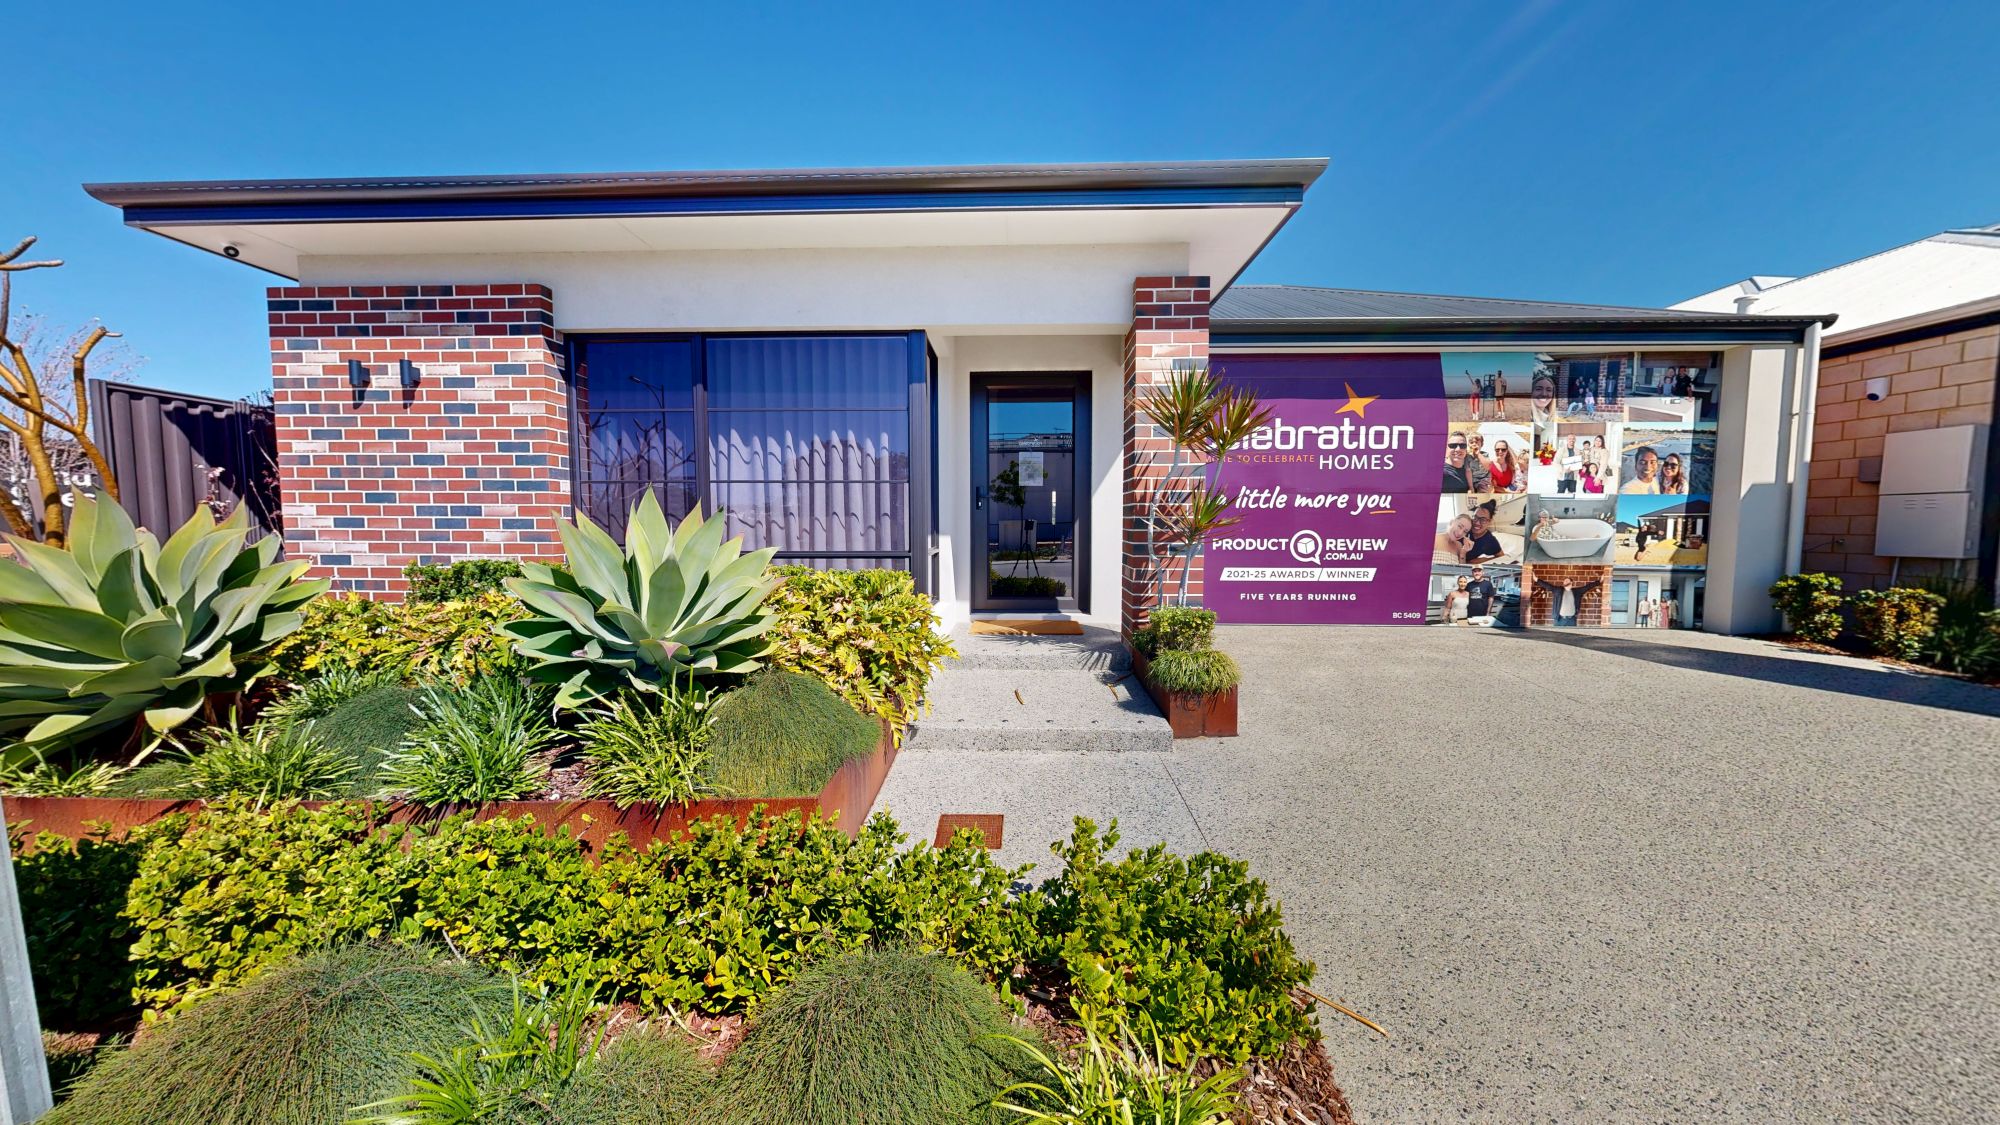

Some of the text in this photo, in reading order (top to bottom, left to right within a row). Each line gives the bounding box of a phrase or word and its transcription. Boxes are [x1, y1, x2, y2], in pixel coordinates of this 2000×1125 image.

[1238, 454, 1251, 463] TO
[1253, 454, 1316, 463] CELEBRATE
[1319, 454, 1395, 470] HOMES
[1235, 485, 1288, 509] little
[1294, 493, 1349, 509] more
[1350, 493, 1392, 516] you
[1212, 538, 1388, 551] PRODUCT REVIEW
[1323, 552, 1364, 561] .COM.AU
[1226, 570, 1370, 579] 2021-25 AWARDS WINNER
[1240, 593, 1357, 601] FIVE YEARS RUNNING
